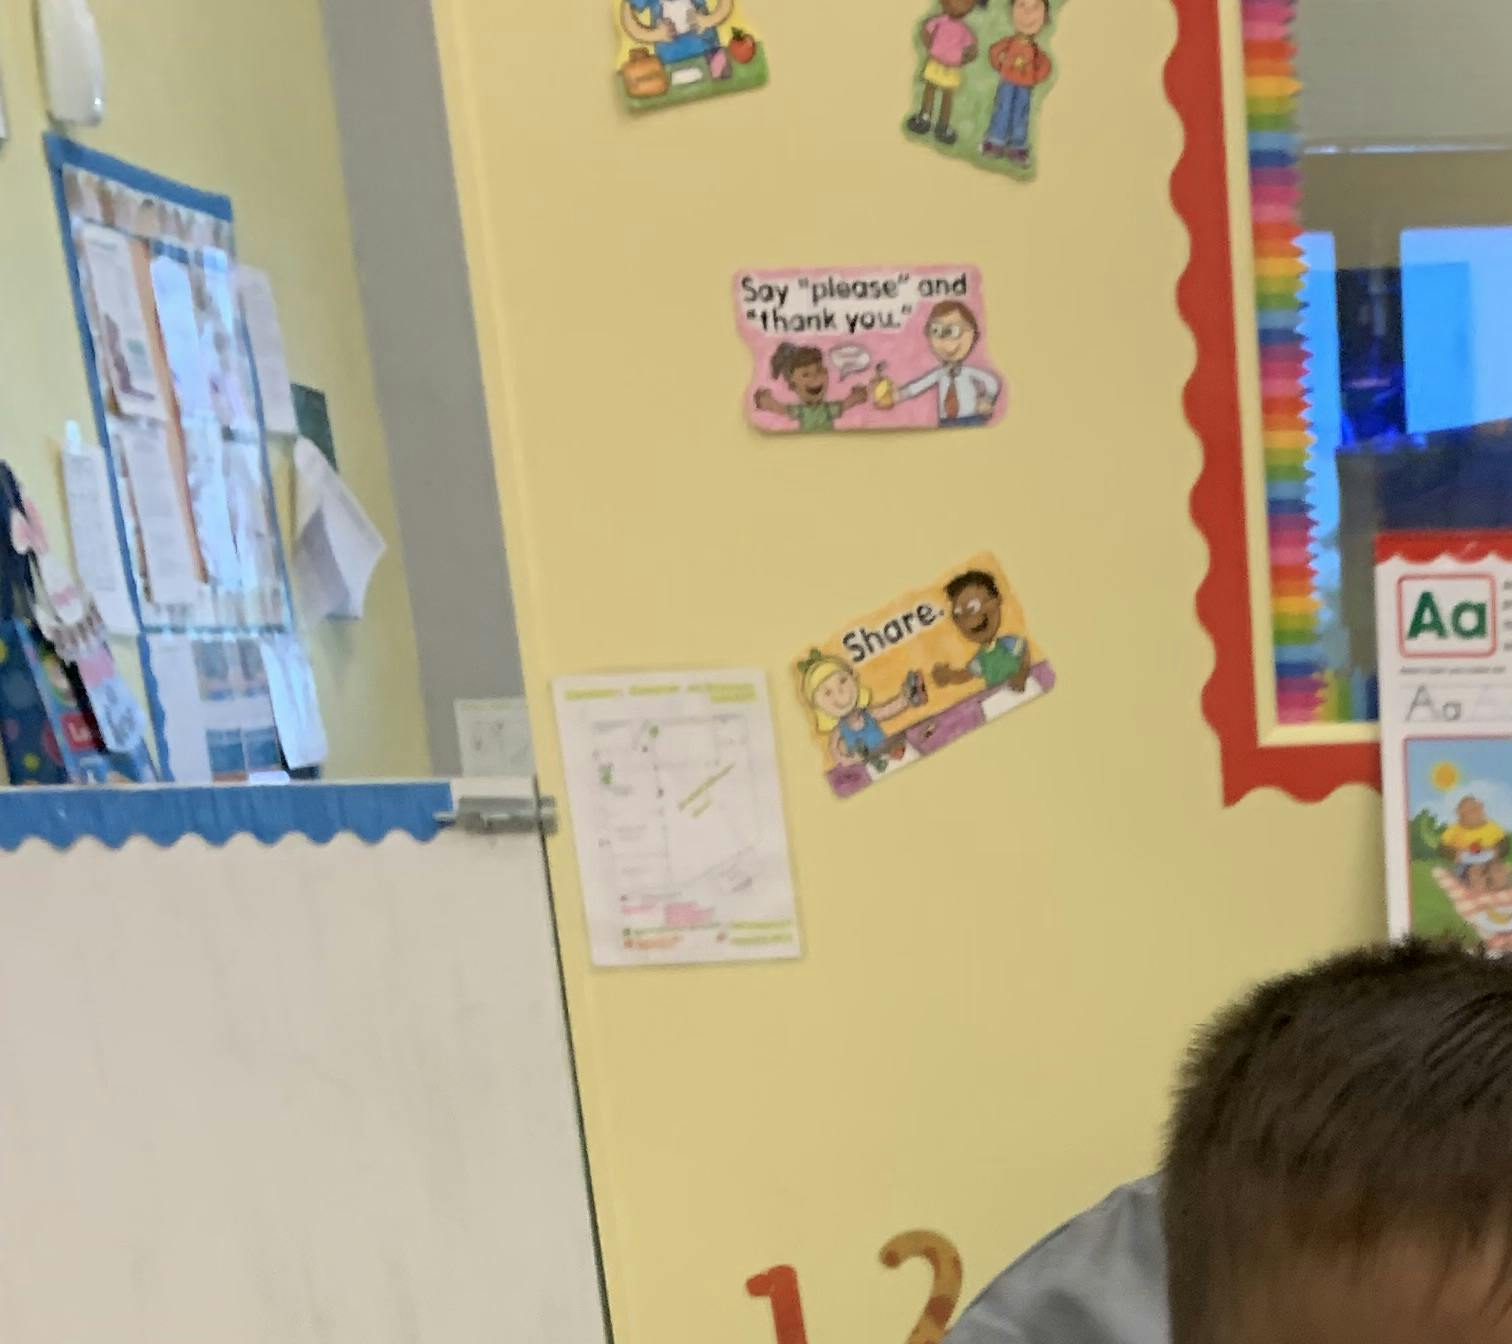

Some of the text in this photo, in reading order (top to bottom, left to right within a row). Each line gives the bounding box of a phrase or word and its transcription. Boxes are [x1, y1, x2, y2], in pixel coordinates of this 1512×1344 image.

[741, 271, 967, 309] Say "please" and
[745, 304, 913, 335] "thank you."
[842, 602, 945, 662] Share.
[1406, 590, 1487, 640] Aa
[1405, 684, 1463, 722] Aa
